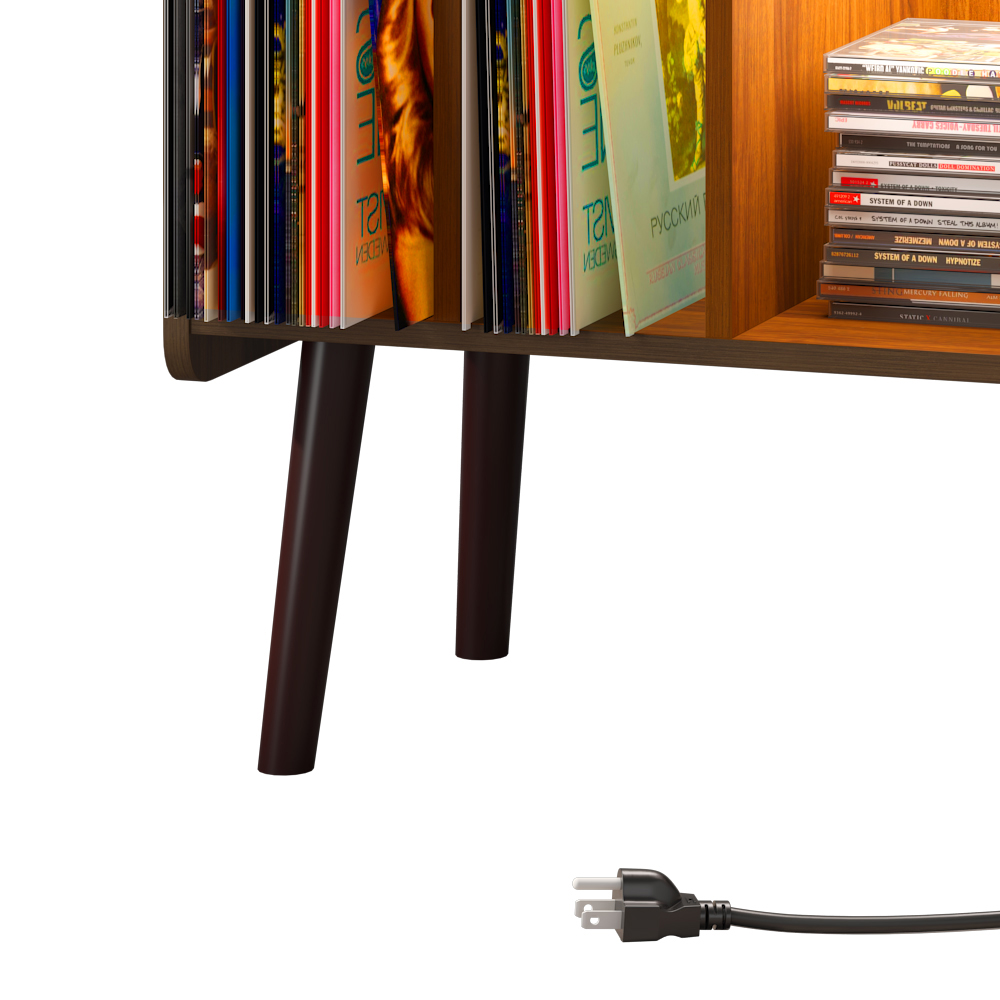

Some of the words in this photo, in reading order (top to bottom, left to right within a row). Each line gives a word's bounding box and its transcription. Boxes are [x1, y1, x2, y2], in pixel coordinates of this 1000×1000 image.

[912, 120, 934, 129] CARRY
[869, 197, 895, 205] SYSTEM
[650, 191, 701, 238] РУССКИЙ
[871, 215, 898, 223] SYSTEM
[894, 235, 933, 245] MEZMERIZE
[938, 238, 959, 247] DOWN
[960, 239, 966, 247] A
[967, 239, 976, 248] OF
[874, 252, 900, 261] SYSTEM
[901, 253, 910, 261] OF
[911, 254, 917, 262] A
[917, 254, 938, 264] DOWN
[945, 256, 982, 266] HYPNOTIZE
[871, 286, 903, 296] STING
[903, 289, 937, 297] MERCURY
[939, 291, 969, 299] FALLING
